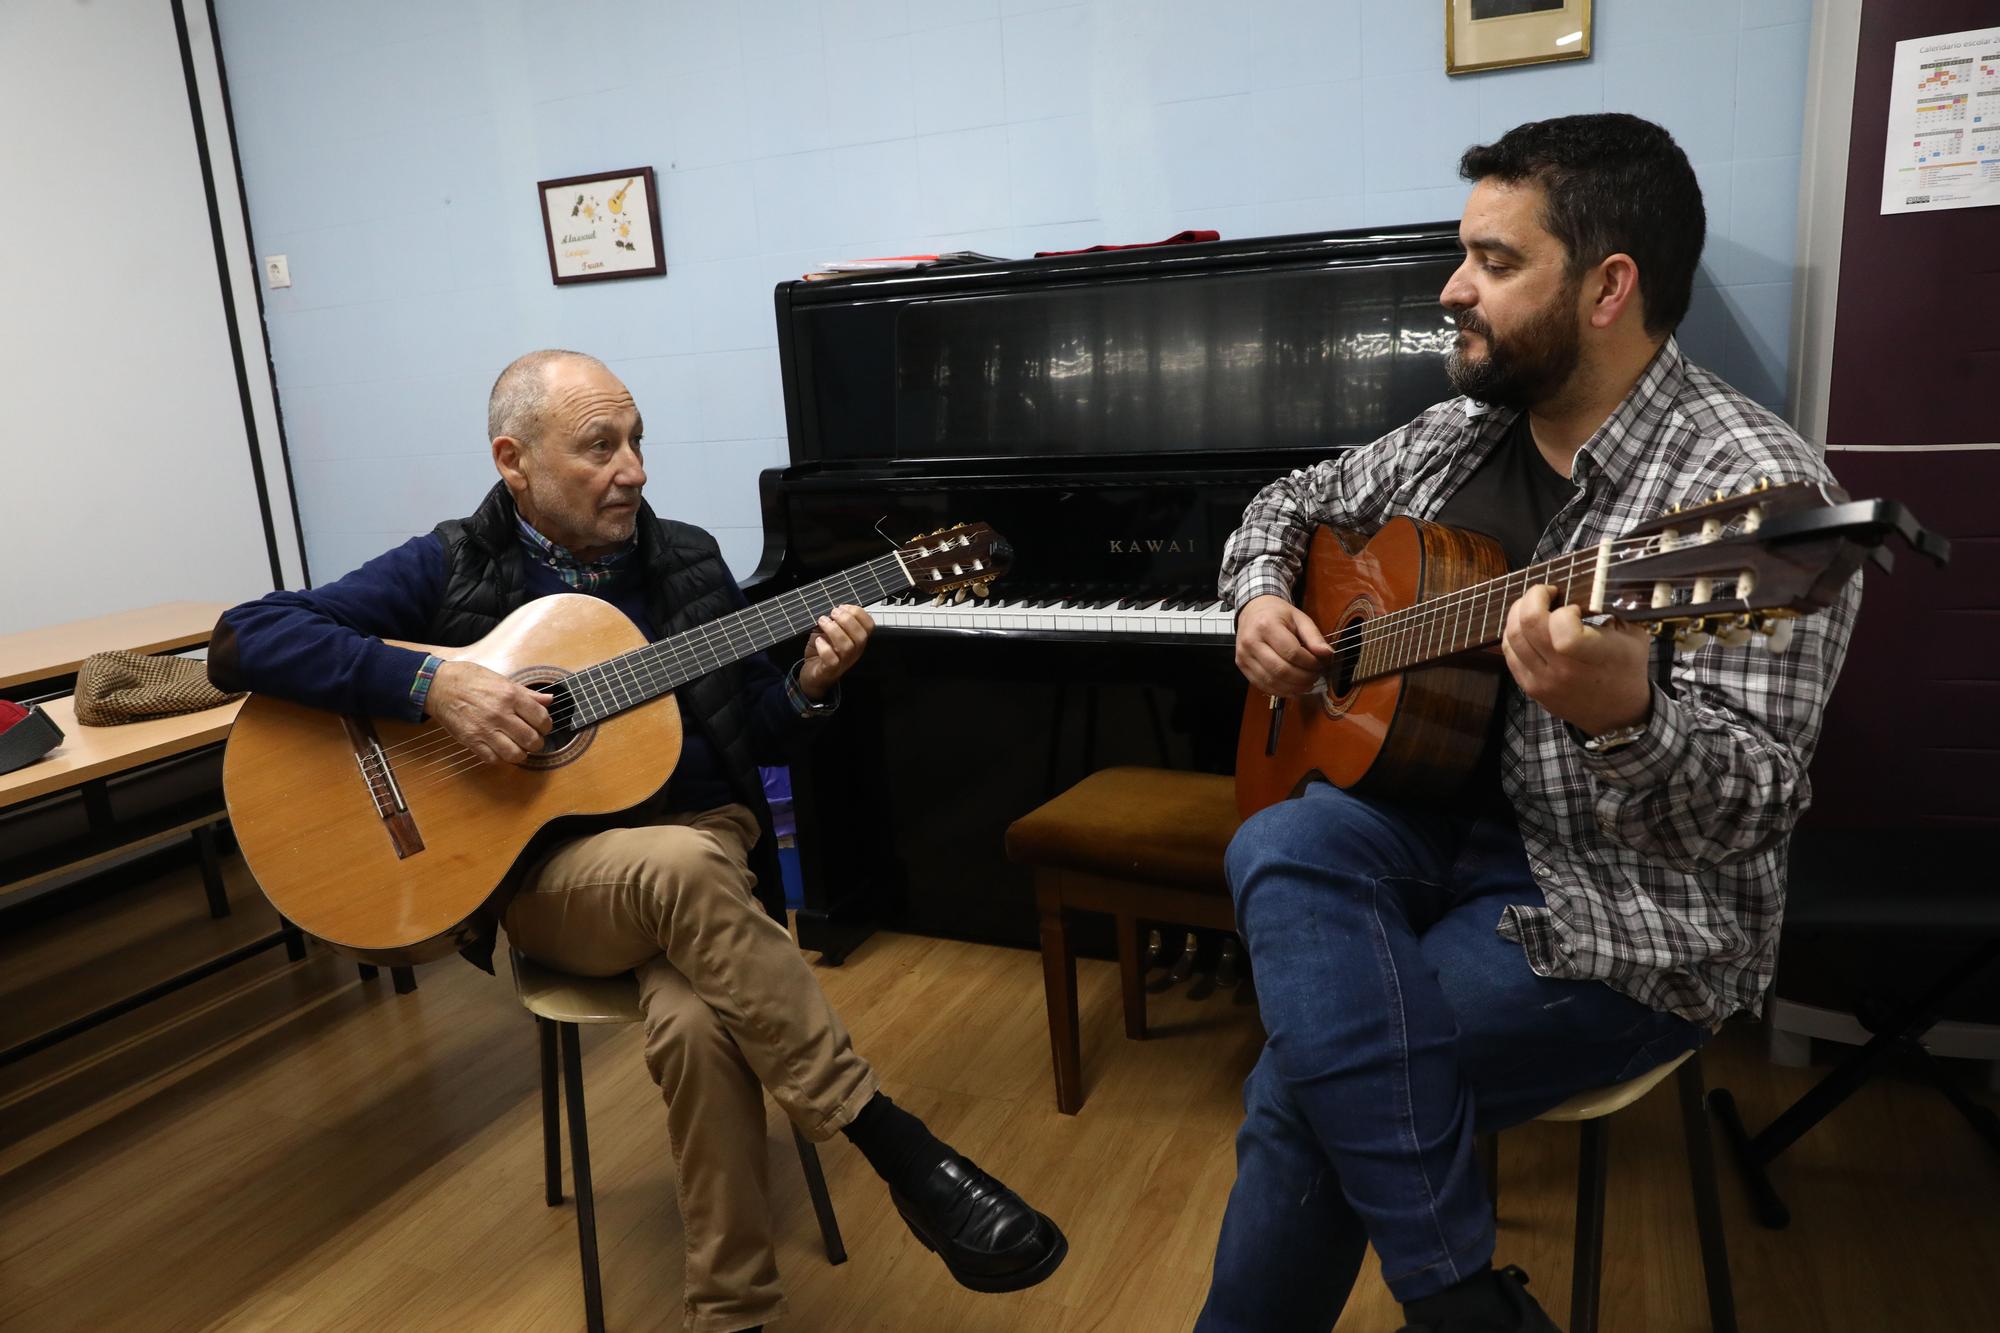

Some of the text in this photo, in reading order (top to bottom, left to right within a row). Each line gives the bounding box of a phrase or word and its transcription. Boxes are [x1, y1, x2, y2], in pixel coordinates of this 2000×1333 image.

[1919, 41, 1961, 54] Calendario
[1963, 37, 1992, 48] escolar
[1109, 539, 1195, 553] KAWAI
